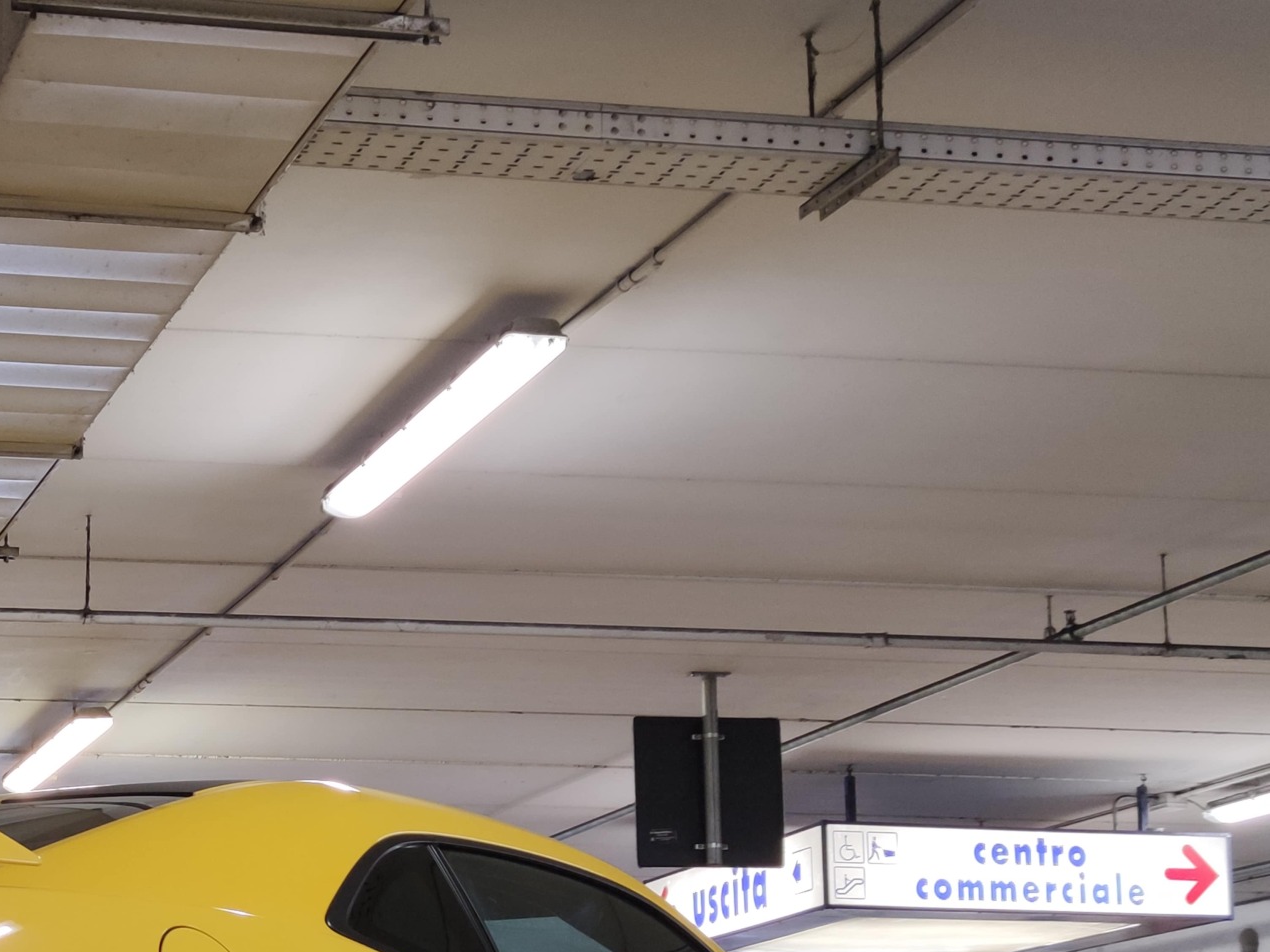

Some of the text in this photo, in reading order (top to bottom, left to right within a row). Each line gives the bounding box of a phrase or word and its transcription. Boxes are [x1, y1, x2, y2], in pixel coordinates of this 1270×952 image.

[974, 838, 1087, 867] centro
[692, 866, 767, 926] uscita
[916, 874, 1145, 905] commerciale
